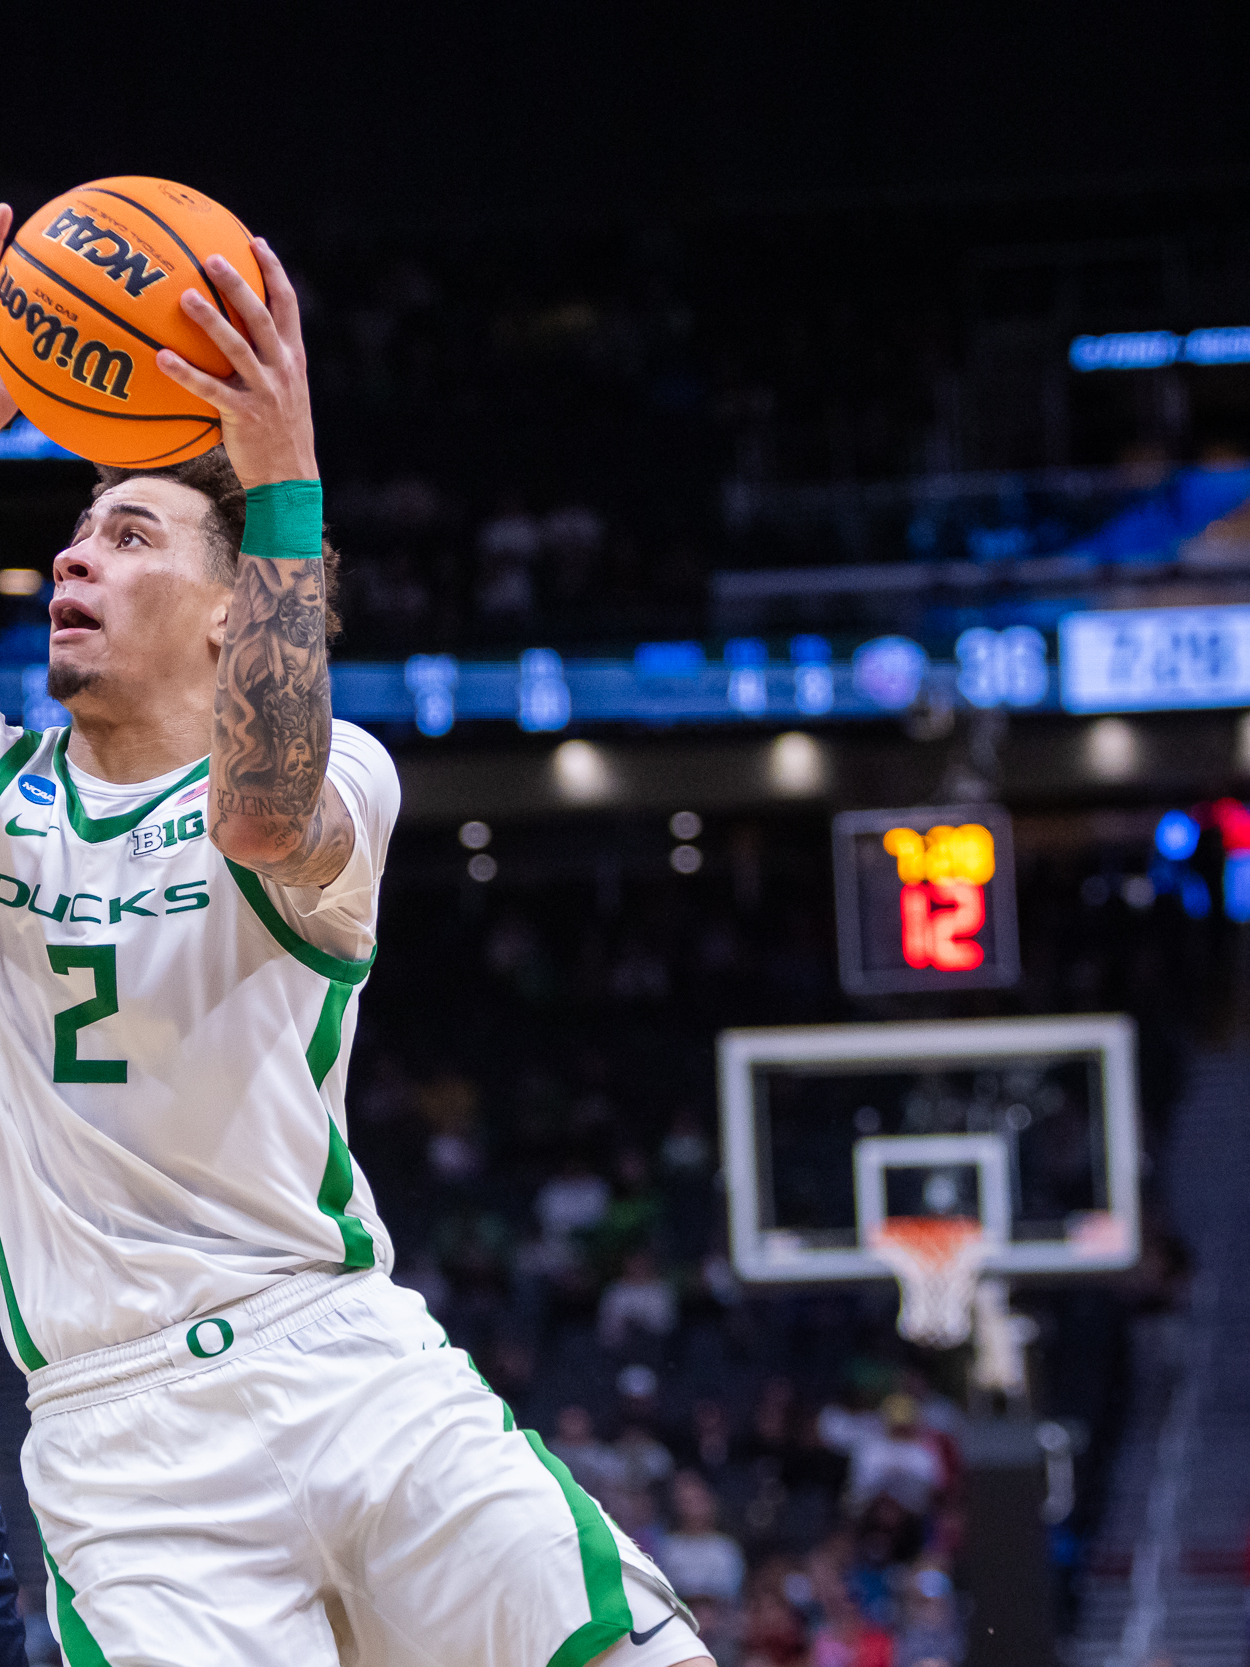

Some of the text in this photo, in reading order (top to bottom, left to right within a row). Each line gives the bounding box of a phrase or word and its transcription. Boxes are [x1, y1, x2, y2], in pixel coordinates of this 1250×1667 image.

[41, 206, 168, 299] NCAA
[55, 303, 78, 322] EVO
[21, 780, 54, 803] NCAA
[217, 788, 275, 817] NEVER
[46, 944, 128, 1084] 2
